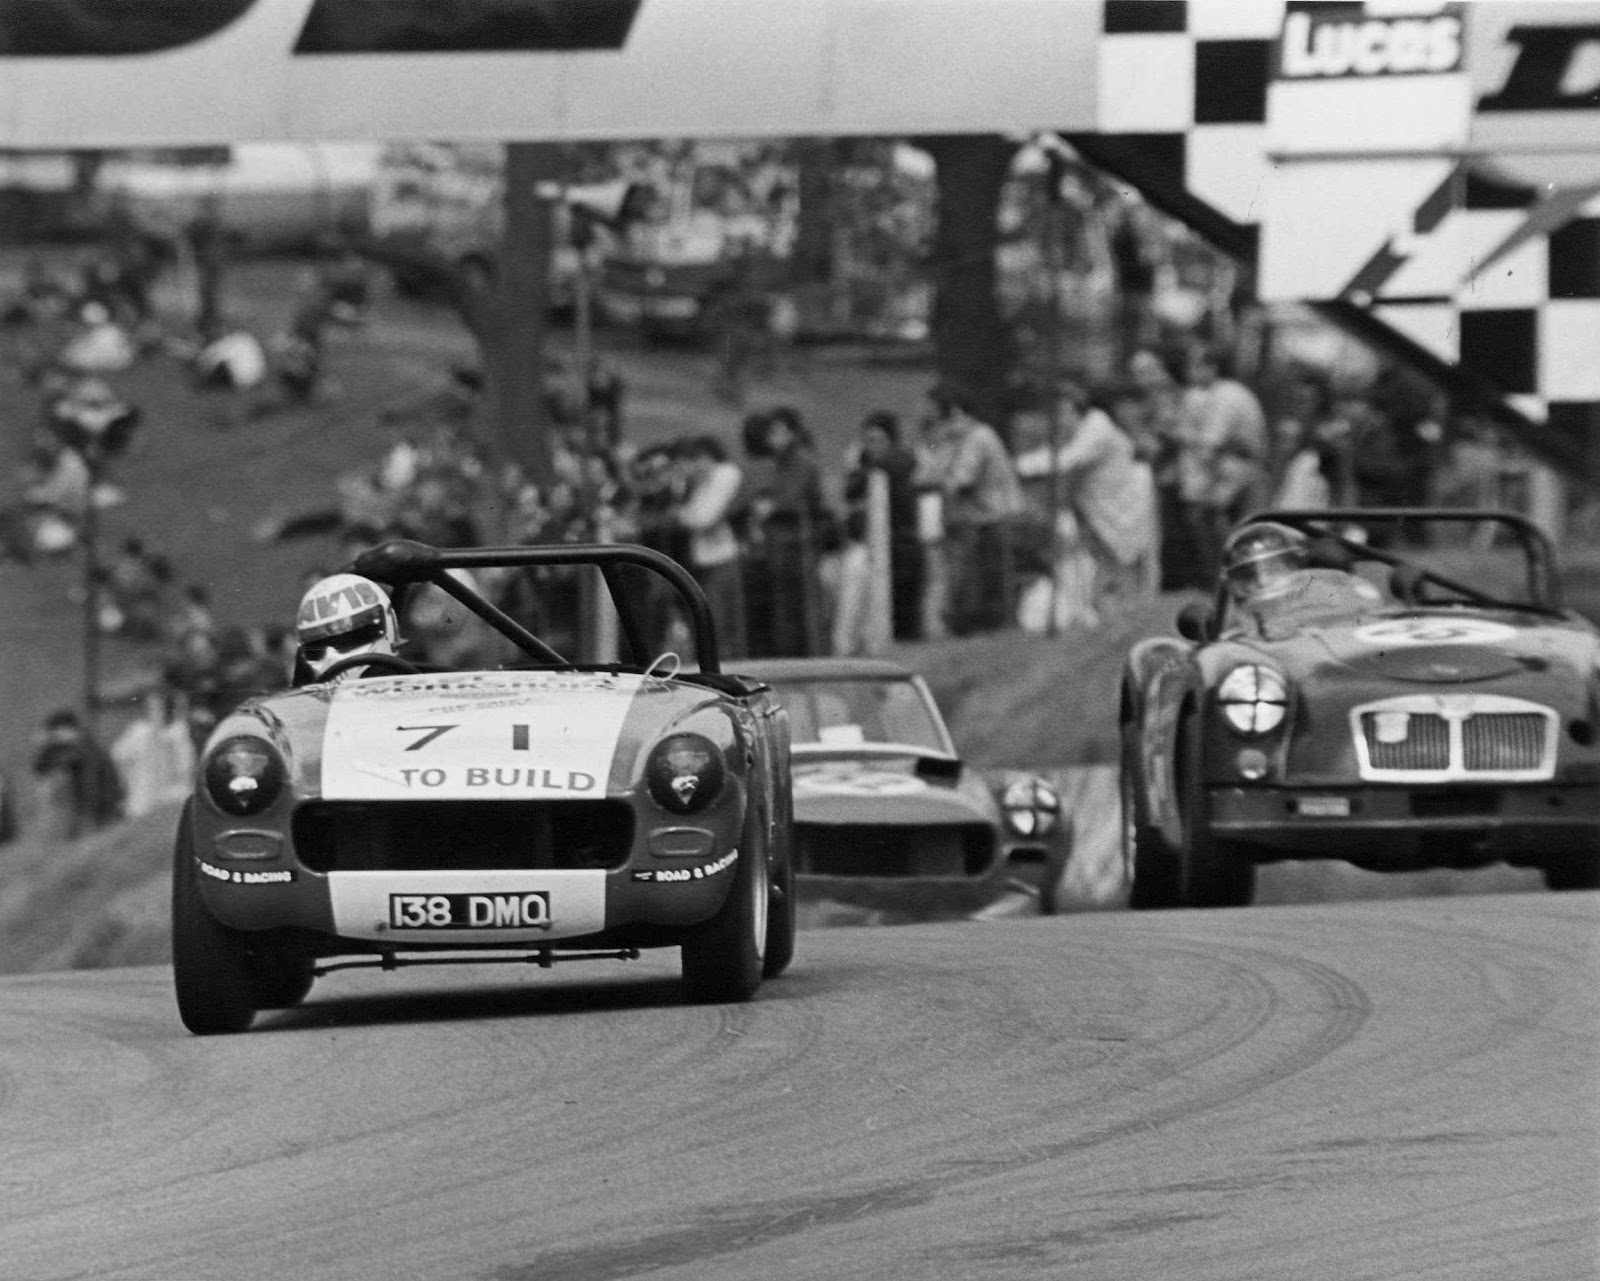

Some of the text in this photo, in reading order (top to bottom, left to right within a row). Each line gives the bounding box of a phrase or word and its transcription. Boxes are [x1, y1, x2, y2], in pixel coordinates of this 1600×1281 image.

[400, 767, 597, 792] TO BUILD
[656, 870, 691, 881] ROAD
[394, 896, 452, 927] 138
